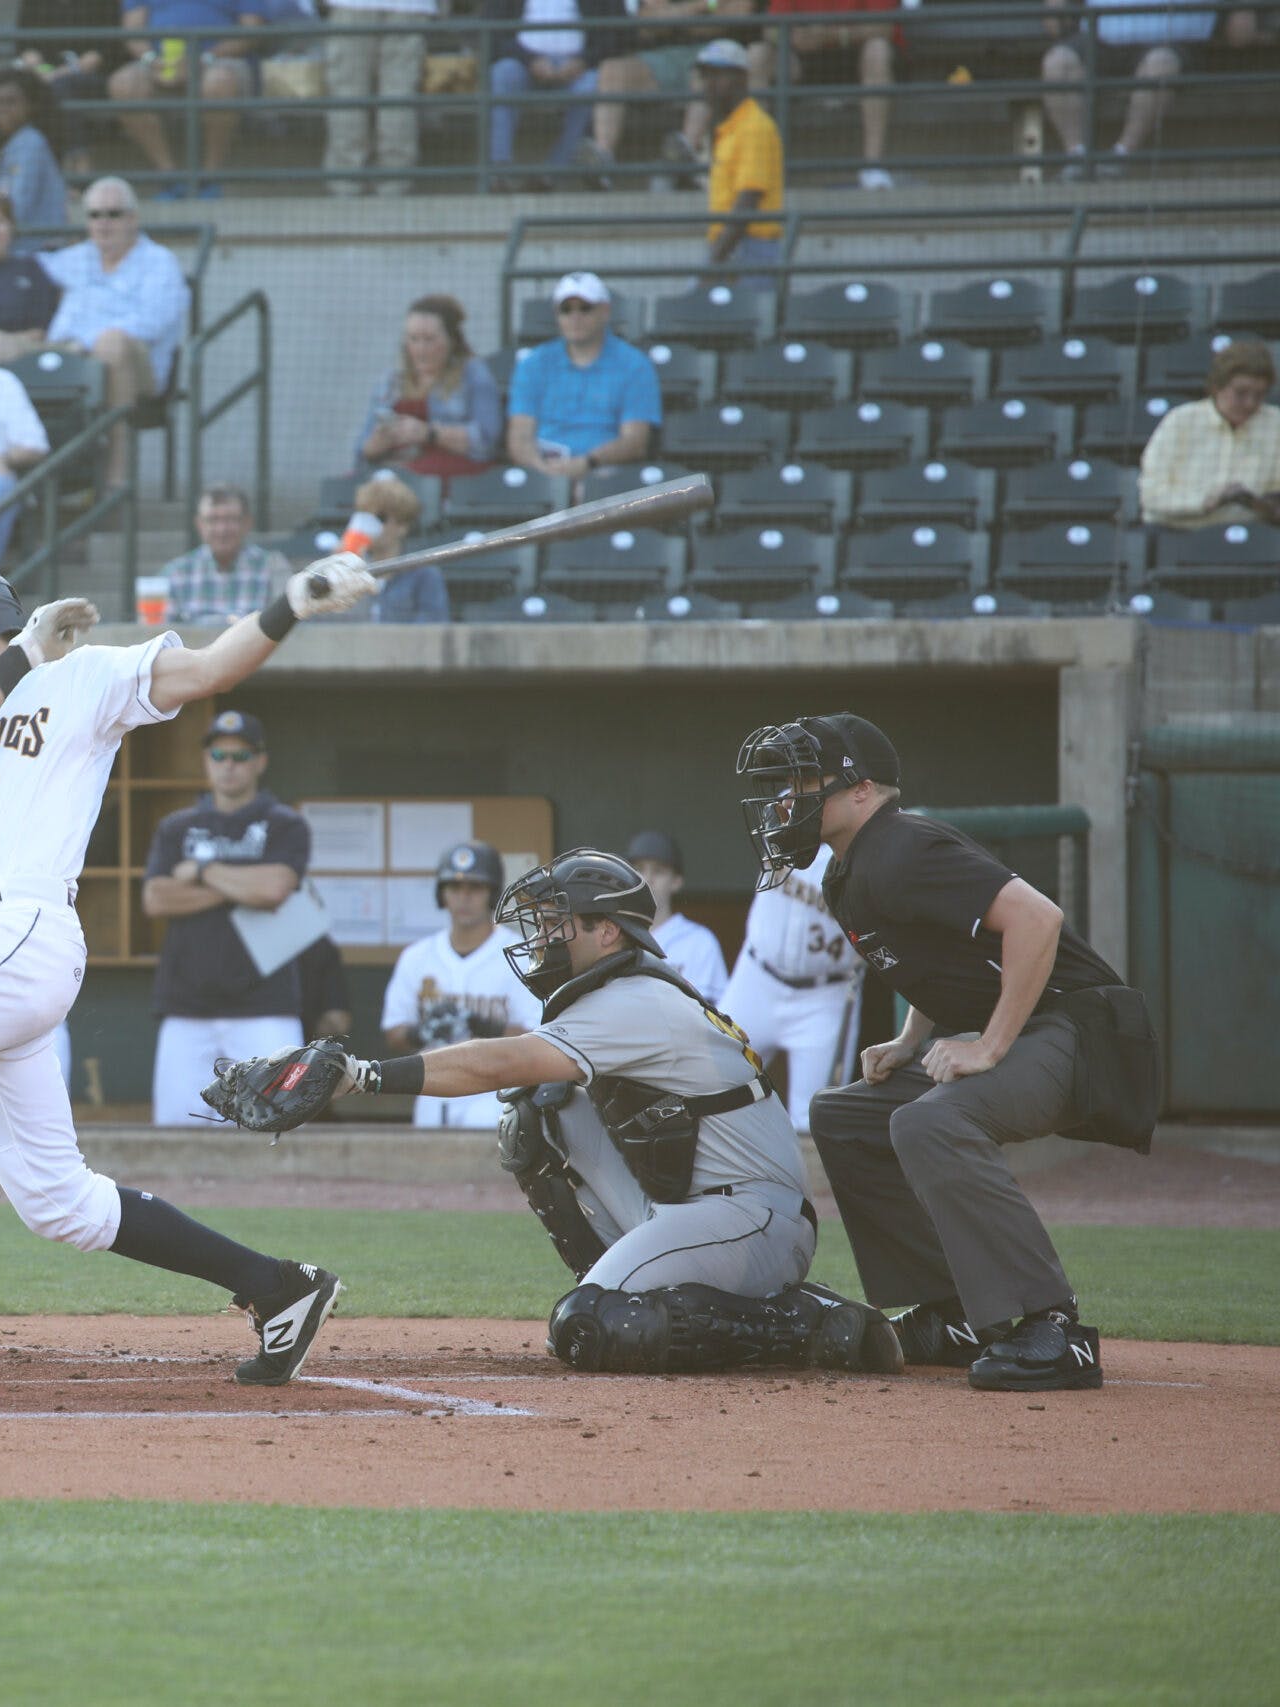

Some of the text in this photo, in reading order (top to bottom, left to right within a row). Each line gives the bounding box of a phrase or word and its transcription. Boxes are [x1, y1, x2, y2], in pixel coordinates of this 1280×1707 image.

[808, 924, 846, 961] 34
[945, 1322, 980, 1346] N
[1070, 1340, 1095, 1367] N
